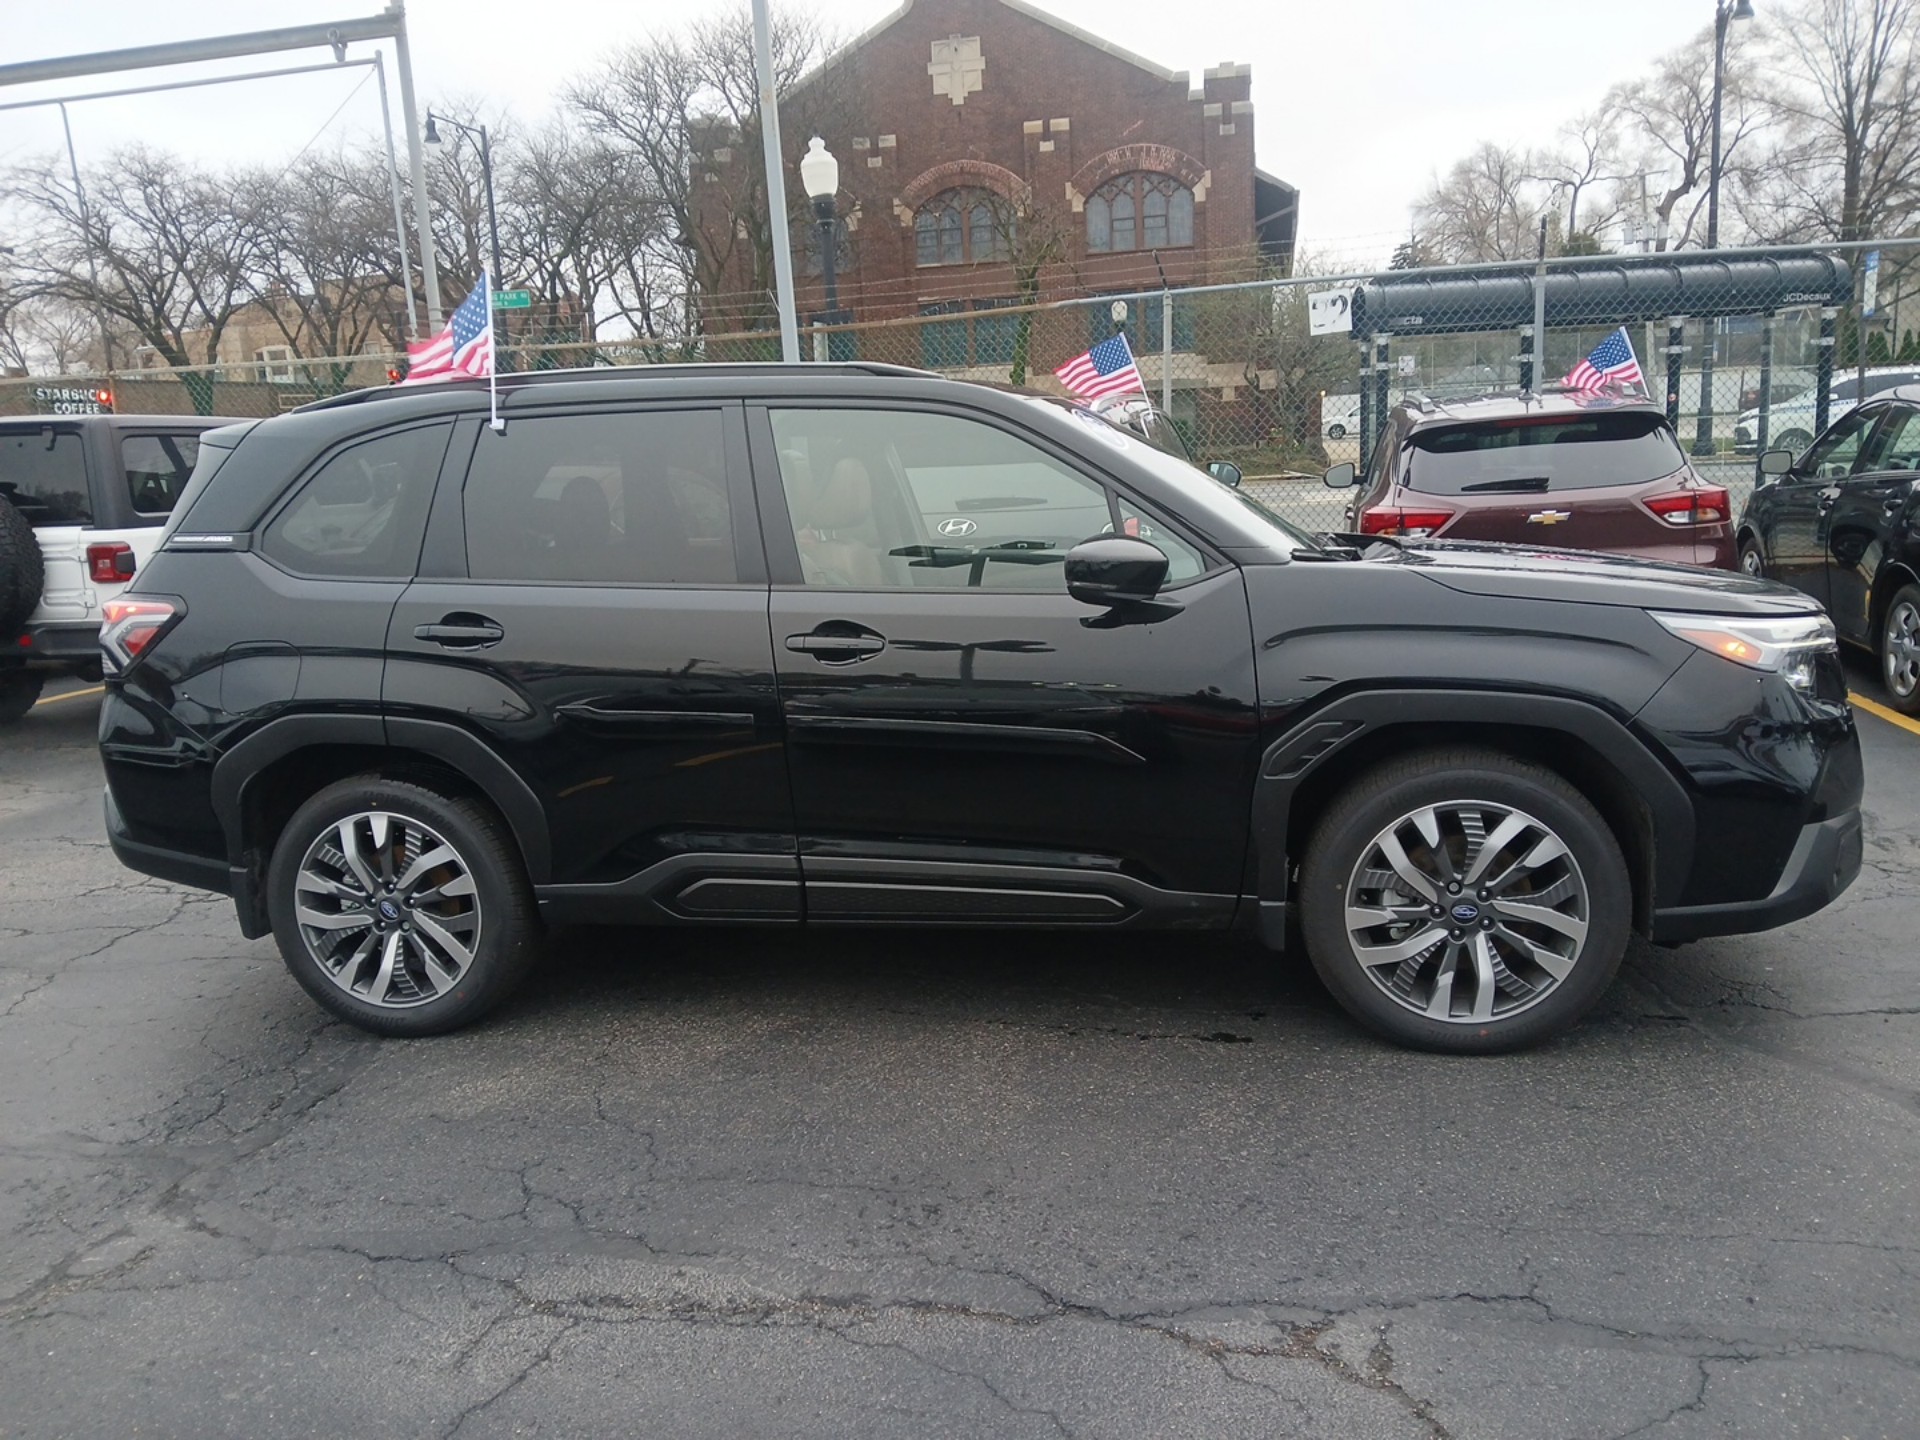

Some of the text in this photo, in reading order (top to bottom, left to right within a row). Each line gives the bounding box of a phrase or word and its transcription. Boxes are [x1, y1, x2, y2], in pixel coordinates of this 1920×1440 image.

[500, 292, 517, 300] PARK
[1783, 292, 1832, 302] JCDecaux
[36, 388, 106, 400] STARBUC
[54, 402, 100, 414] COFFEE
